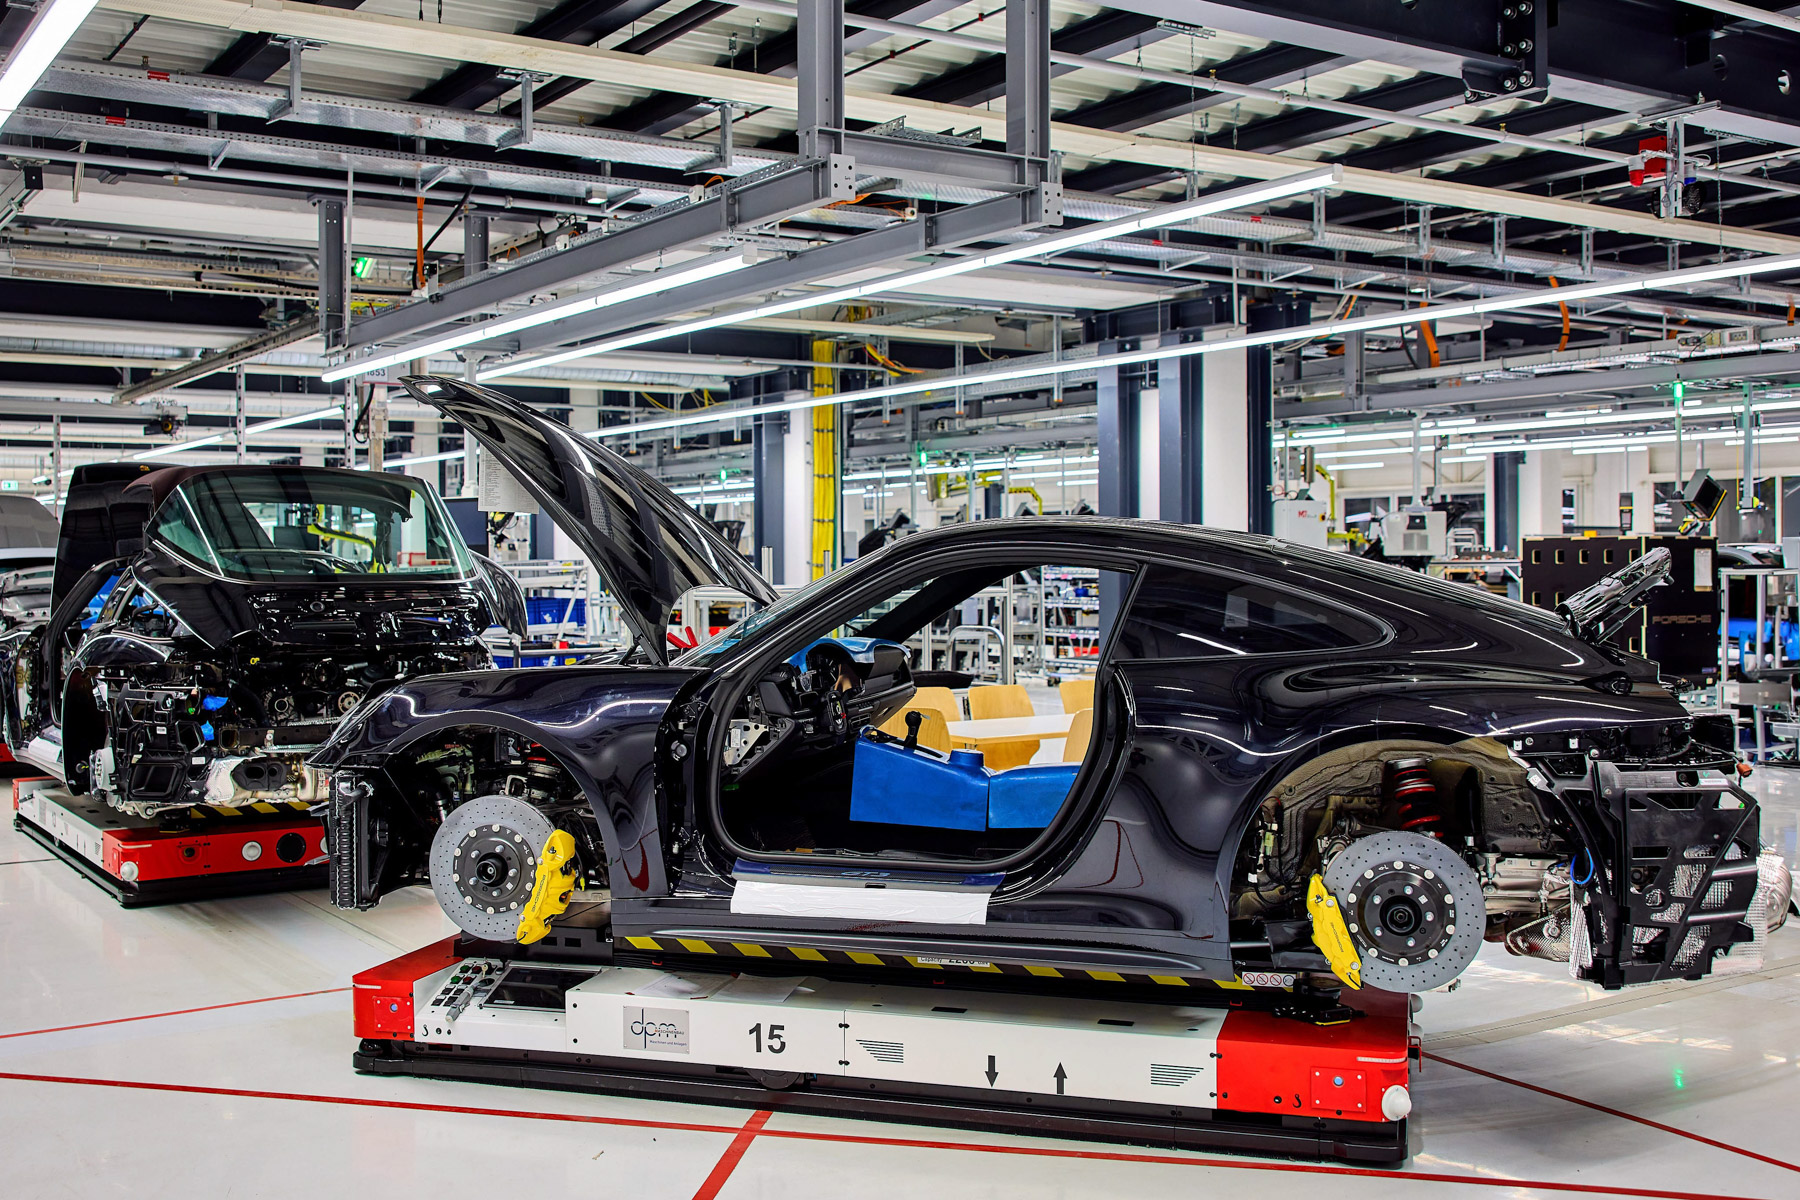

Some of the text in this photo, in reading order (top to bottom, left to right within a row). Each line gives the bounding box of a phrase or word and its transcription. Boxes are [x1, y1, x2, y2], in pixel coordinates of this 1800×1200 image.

[1652, 614, 1712, 625] PORSCHE
[531, 874, 547, 913] PORSCHE
[630, 1008, 676, 1049] dpm
[748, 1022, 787, 1055] 15
